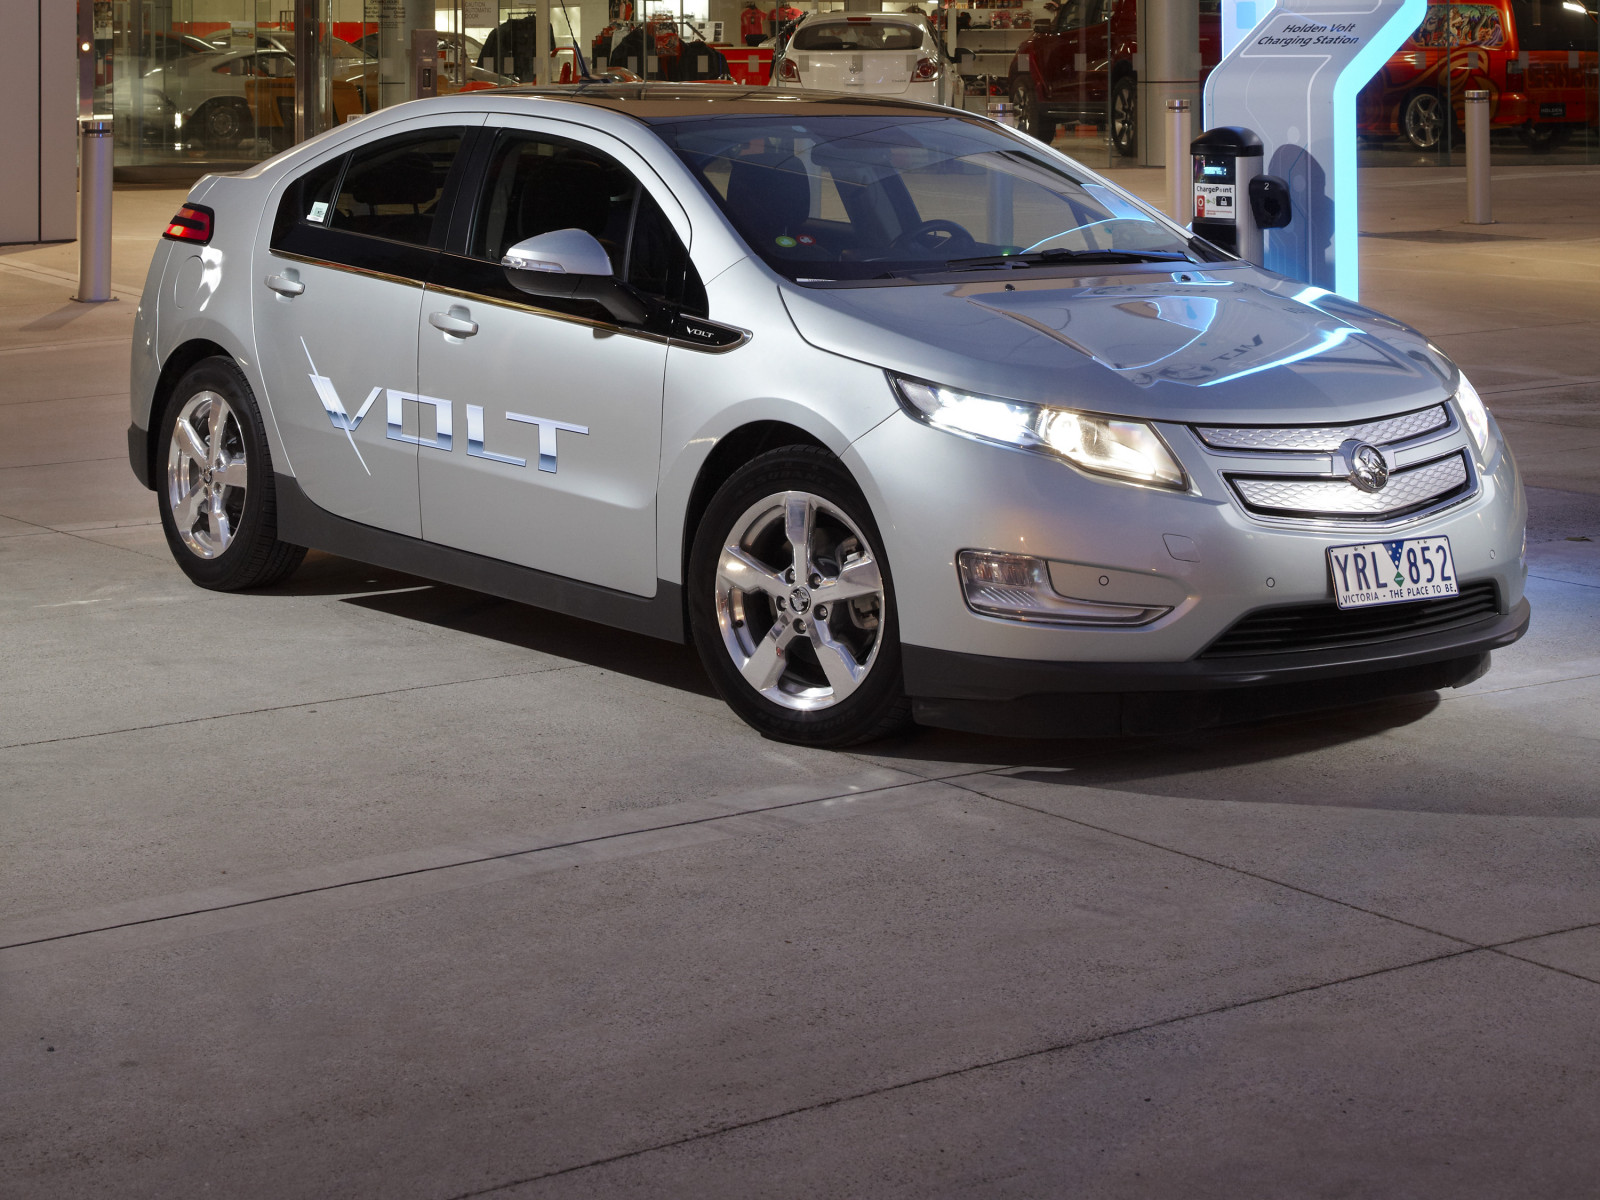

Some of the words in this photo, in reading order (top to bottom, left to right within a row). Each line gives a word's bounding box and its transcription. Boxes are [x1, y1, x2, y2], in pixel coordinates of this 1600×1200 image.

[1282, 23, 1328, 33] Holden
[1329, 23, 1356, 33] Volt
[1258, 35, 1312, 48] Charging
[1313, 35, 1360, 45] Station
[1196, 185, 1233, 194] ChargePoint
[1264, 182, 1270, 191] 2
[686, 325, 715, 338] VOLT
[307, 373, 590, 474] VOLT
[1334, 550, 1388, 592] YRL
[1406, 544, 1452, 585] 852
[1342, 592, 1380, 604] VICTORIA
[1389, 588, 1404, 599] THE
[1407, 586, 1429, 597] PLACE
[1432, 584, 1442, 594] TO
